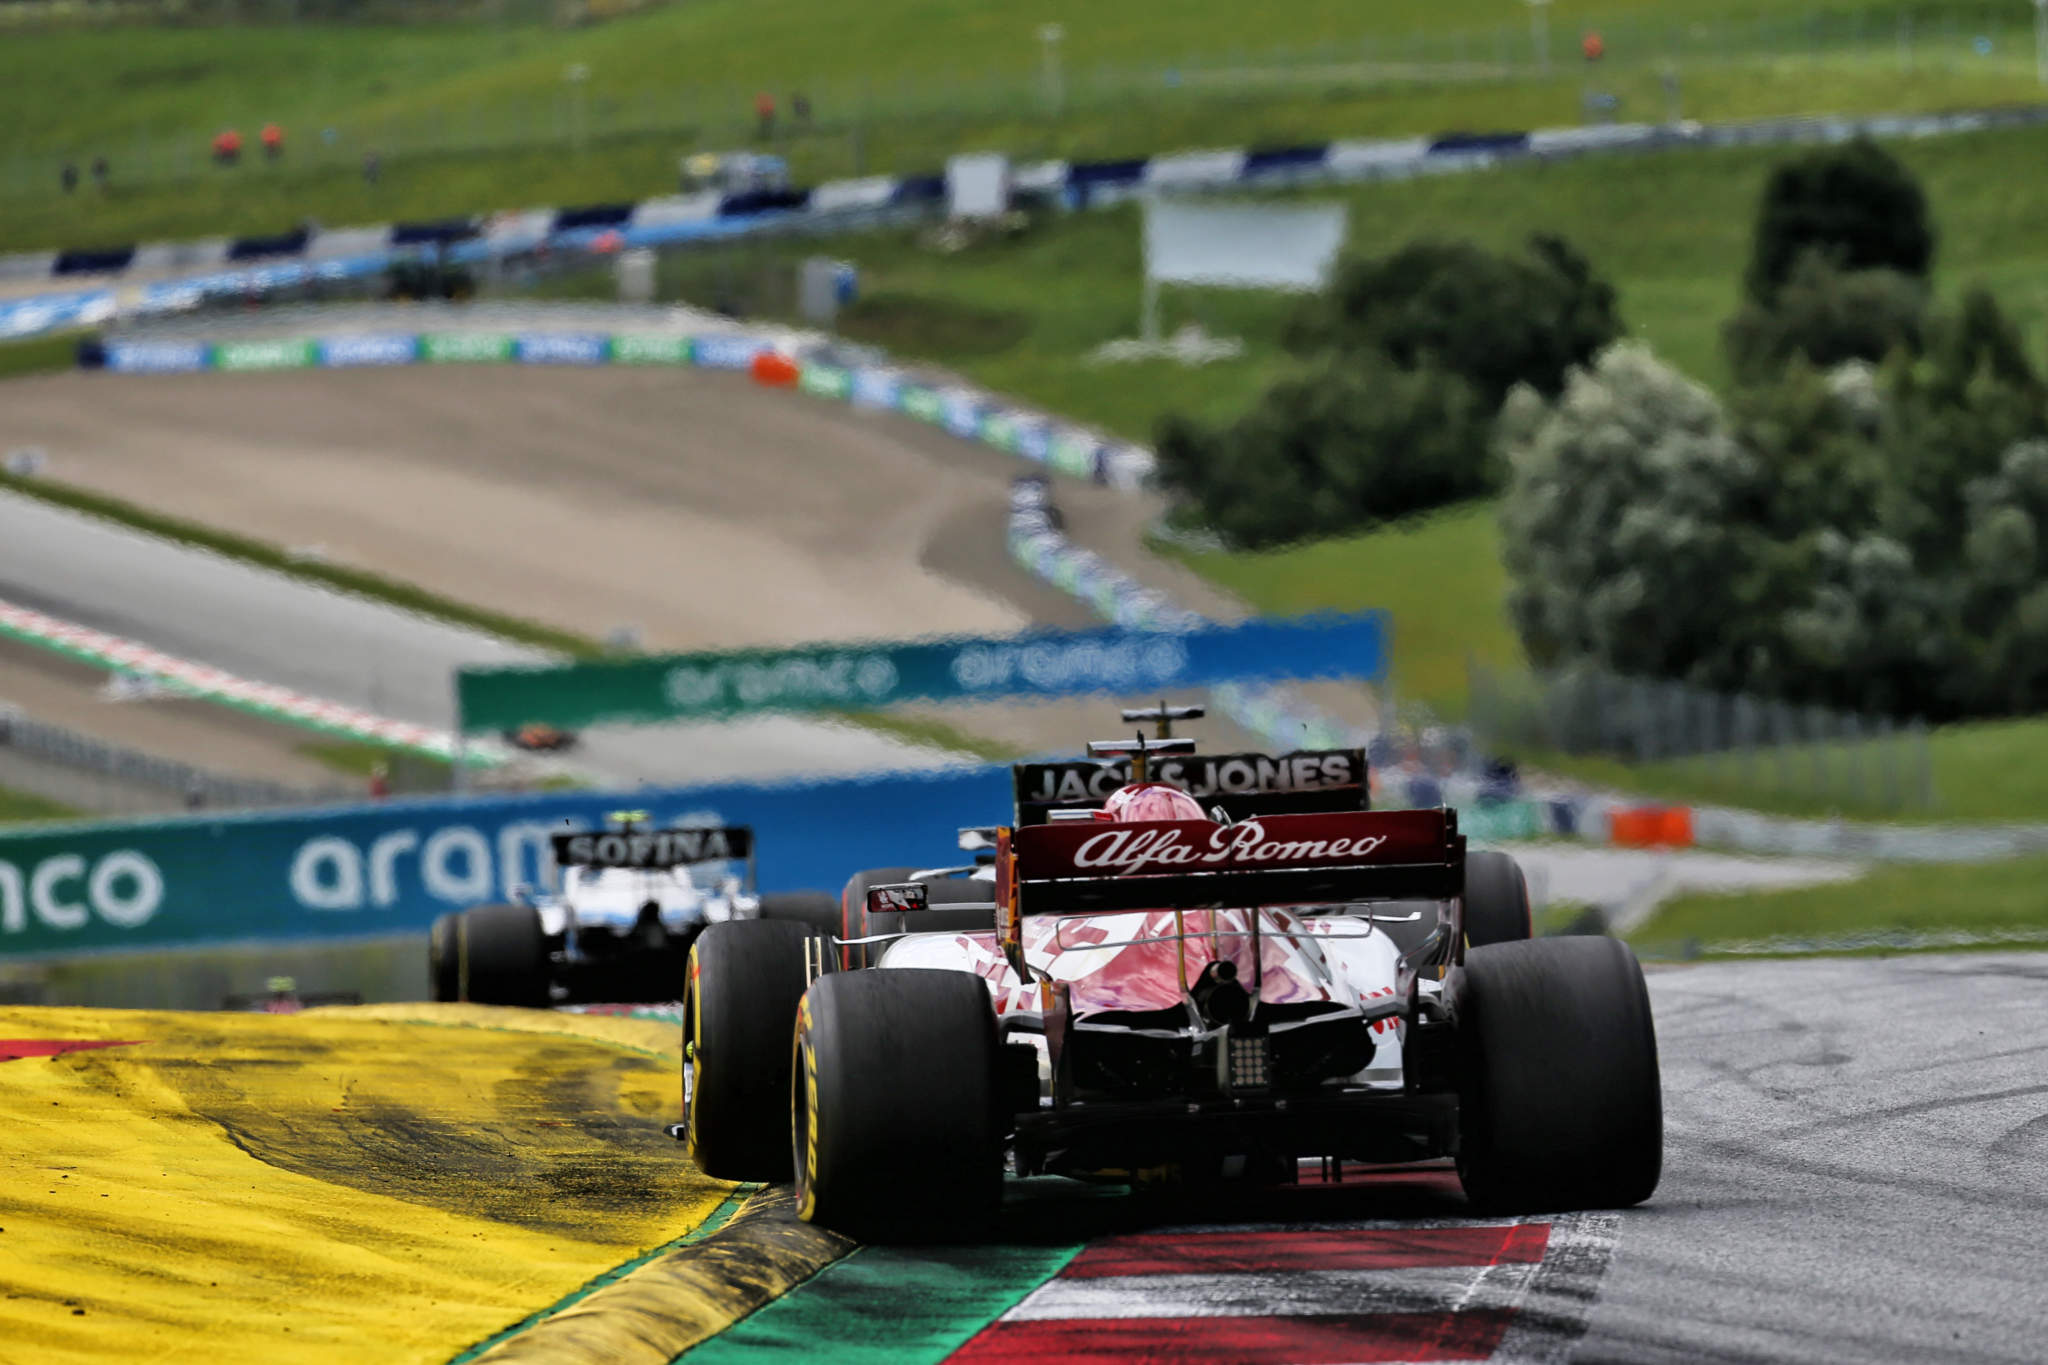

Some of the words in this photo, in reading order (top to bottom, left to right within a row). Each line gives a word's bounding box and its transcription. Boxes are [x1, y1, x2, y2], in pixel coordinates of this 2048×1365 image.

[567, 831, 730, 867] SOFINA
[1073, 829, 1200, 876] Alfa
[1200, 818, 1387, 864] Romeo
[0, 850, 164, 934] co
